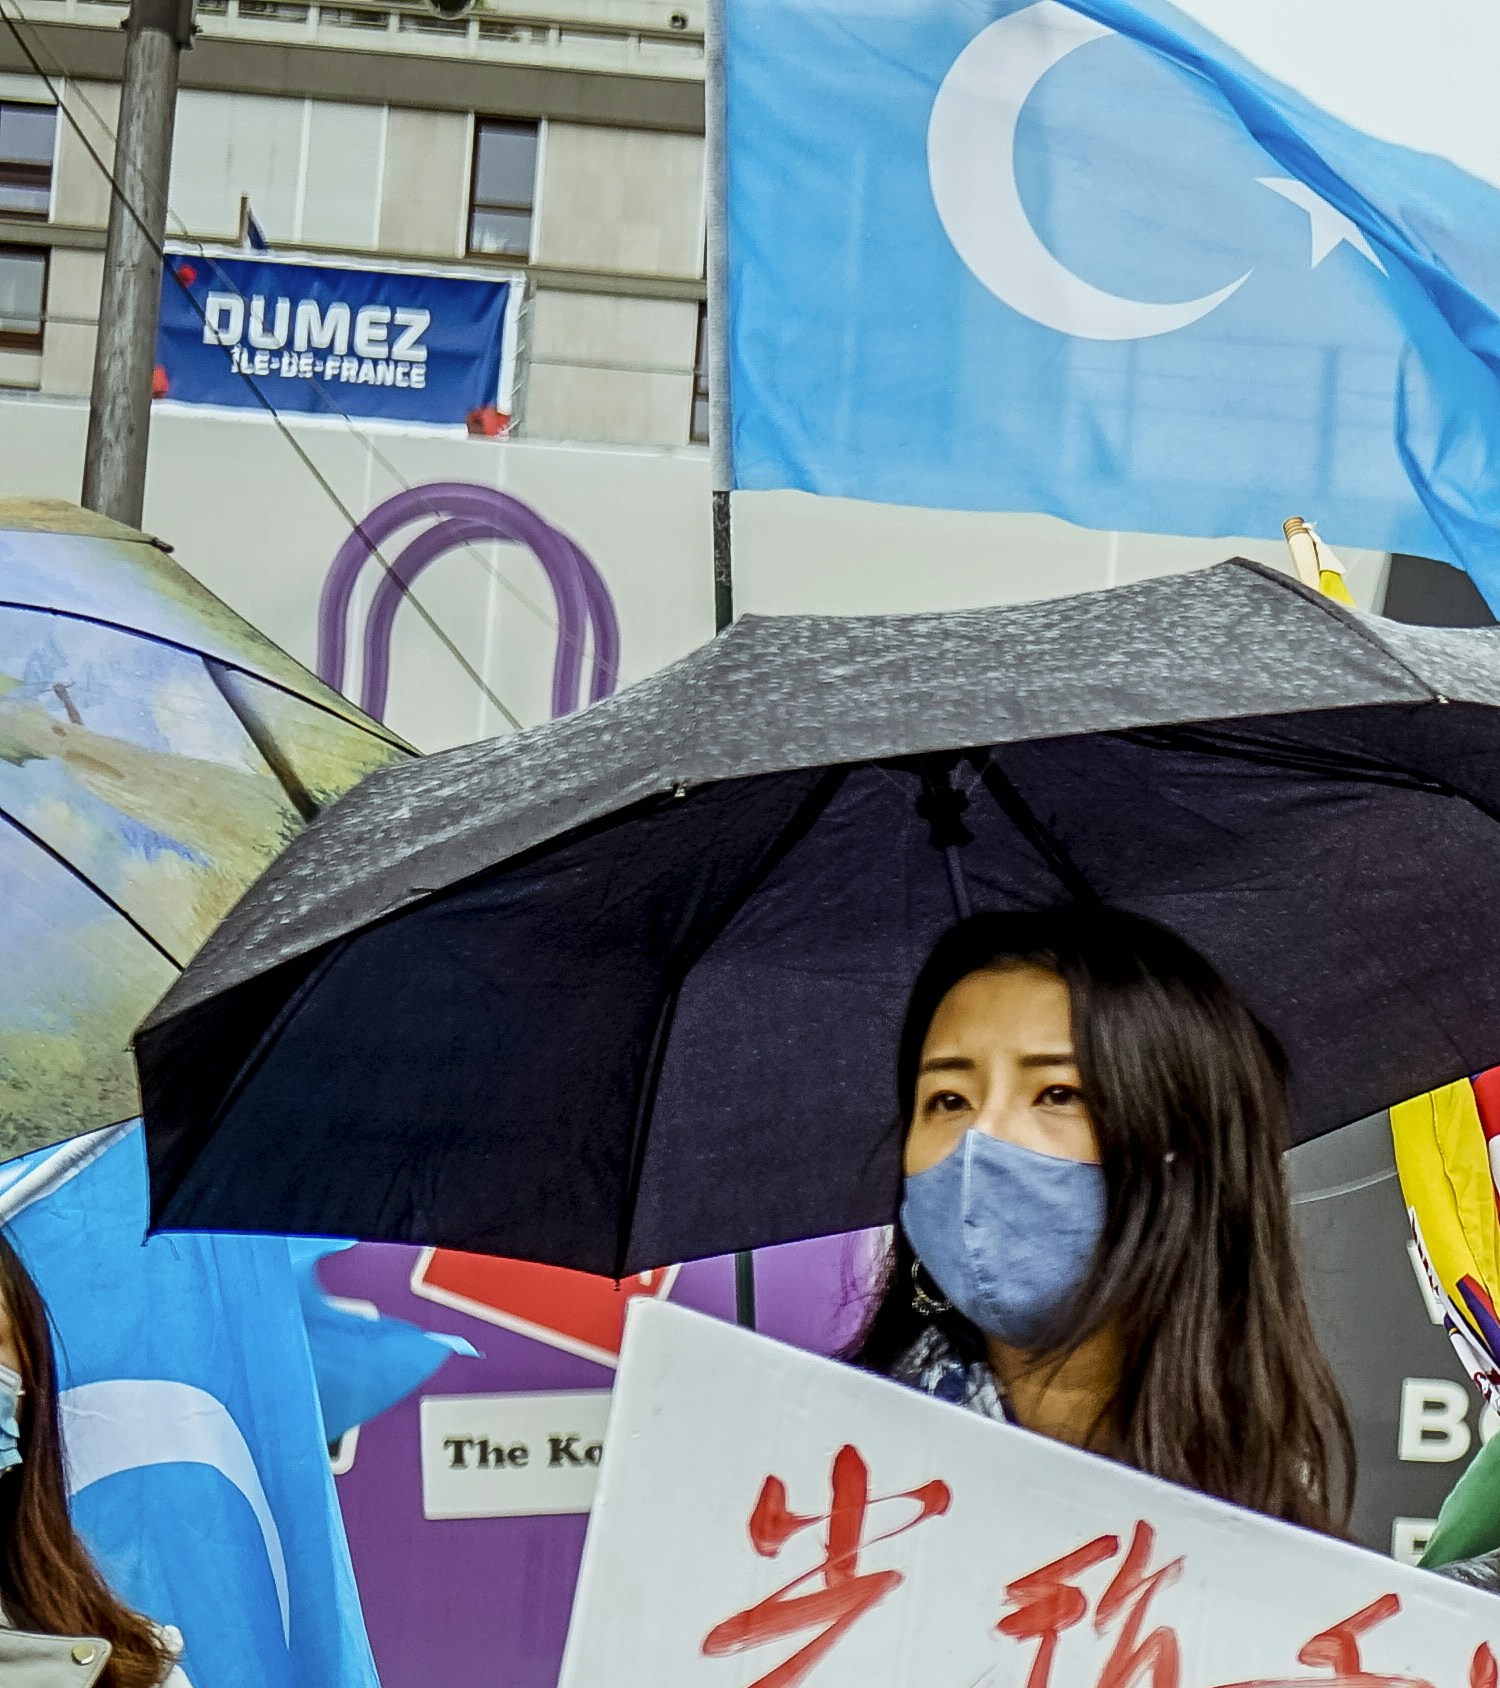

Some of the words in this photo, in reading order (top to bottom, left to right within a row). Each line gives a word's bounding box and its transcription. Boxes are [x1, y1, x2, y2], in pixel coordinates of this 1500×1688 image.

[203, 291, 431, 361] DUMEZ
[231, 343, 427, 388] ÎLE-DE-FRANCE
[444, 1436, 530, 1471] The
